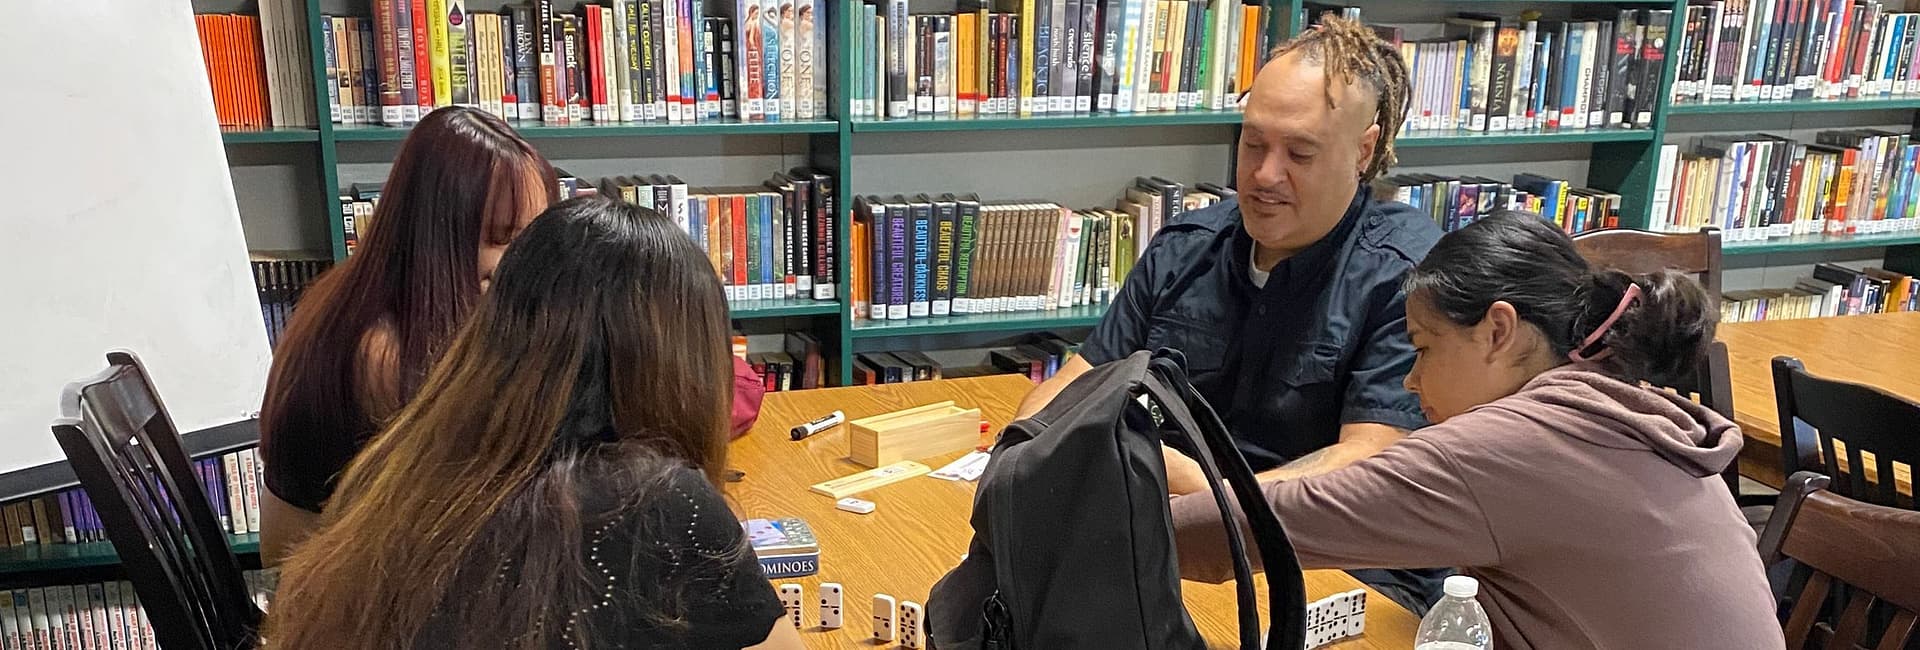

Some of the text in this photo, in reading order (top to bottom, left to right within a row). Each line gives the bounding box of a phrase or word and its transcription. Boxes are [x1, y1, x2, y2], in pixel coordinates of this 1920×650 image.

[541, 0, 550, 22] PEARL
[416, 28, 425, 57] BOYS
[516, 24, 526, 62] BROWN
[525, 32, 533, 55] DAN
[565, 35, 577, 69] smack
[630, 39, 639, 71] TUESDAY
[1036, 25, 1050, 97] BLACK IC
[1066, 28, 1076, 68] crescendo
[1081, 32, 1094, 72] silence
[1105, 30, 1118, 69] finale
[452, 64, 467, 89] LIST
[748, 50, 760, 85] ELITE
[766, 38, 778, 100] SELECTION
[781, 49, 793, 85] ONE
[800, 50, 812, 86] ONE
[1493, 63, 1507, 112] NARNIA
[818, 207, 826, 277] SUZANNE COLLINS
[891, 218, 904, 261] BEAUTIFUL
[915, 219, 928, 262] BEAUTIFUL
[936, 221, 953, 291] BEAUTIFUL CHAOS
[956, 215, 973, 294] BEAUTIFUL REDEMPTION
[760, 560, 814, 575] OMINOES
